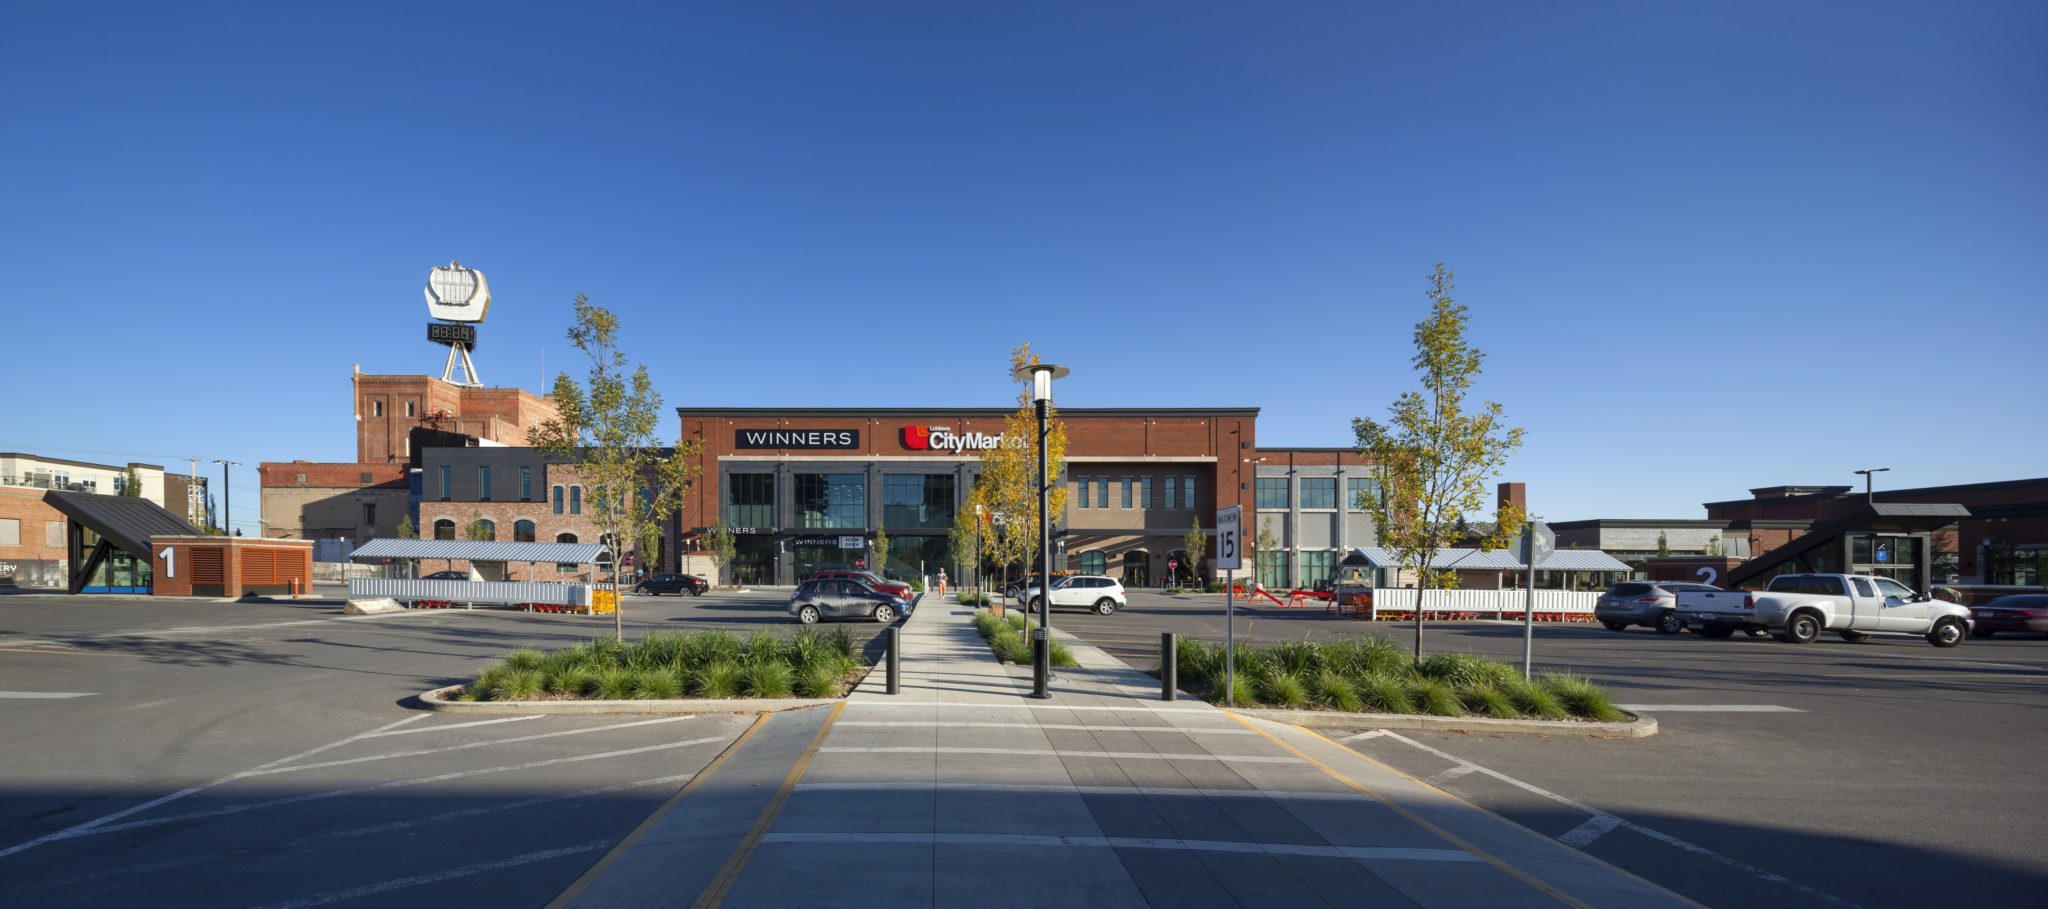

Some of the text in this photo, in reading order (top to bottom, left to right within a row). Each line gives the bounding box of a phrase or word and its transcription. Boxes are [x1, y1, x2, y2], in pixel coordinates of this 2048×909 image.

[746, 432, 852, 445] WINNERS
[1221, 531, 1234, 558] 15
[159, 547, 174, 578] 1
[1696, 567, 1717, 585] 2
